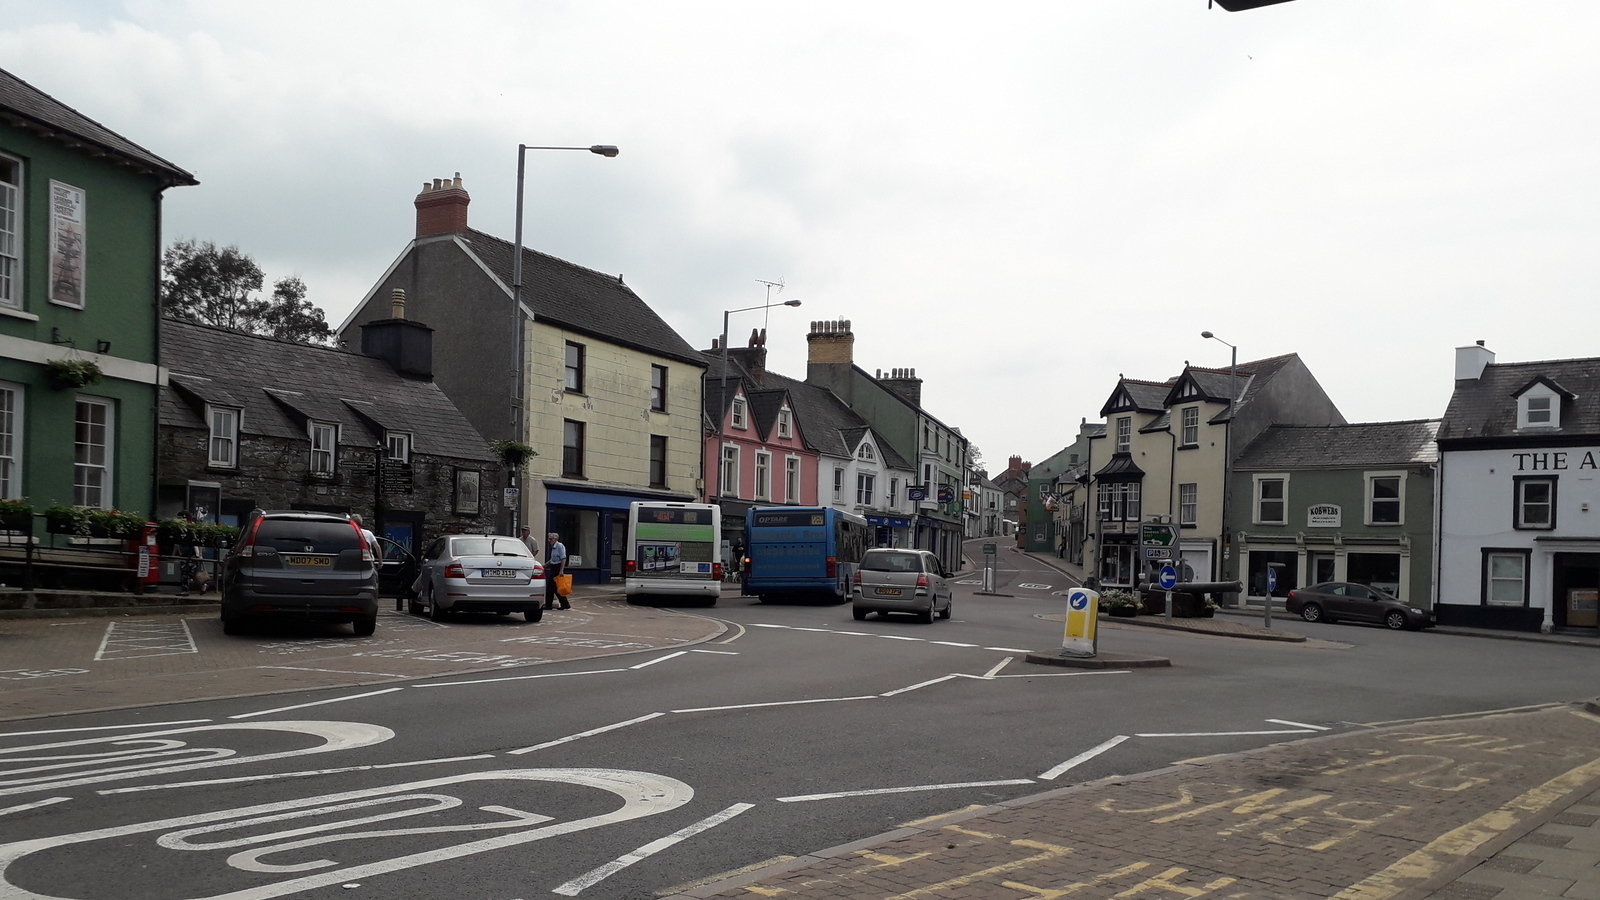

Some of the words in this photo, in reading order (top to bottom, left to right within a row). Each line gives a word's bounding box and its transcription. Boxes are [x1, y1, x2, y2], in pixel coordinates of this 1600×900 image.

[1512, 452, 1568, 471] THE
[1579, 451, 1600, 470] A
[1310, 506, 1338, 515] KOBWEBS
[155, 793, 556, 873] 20
